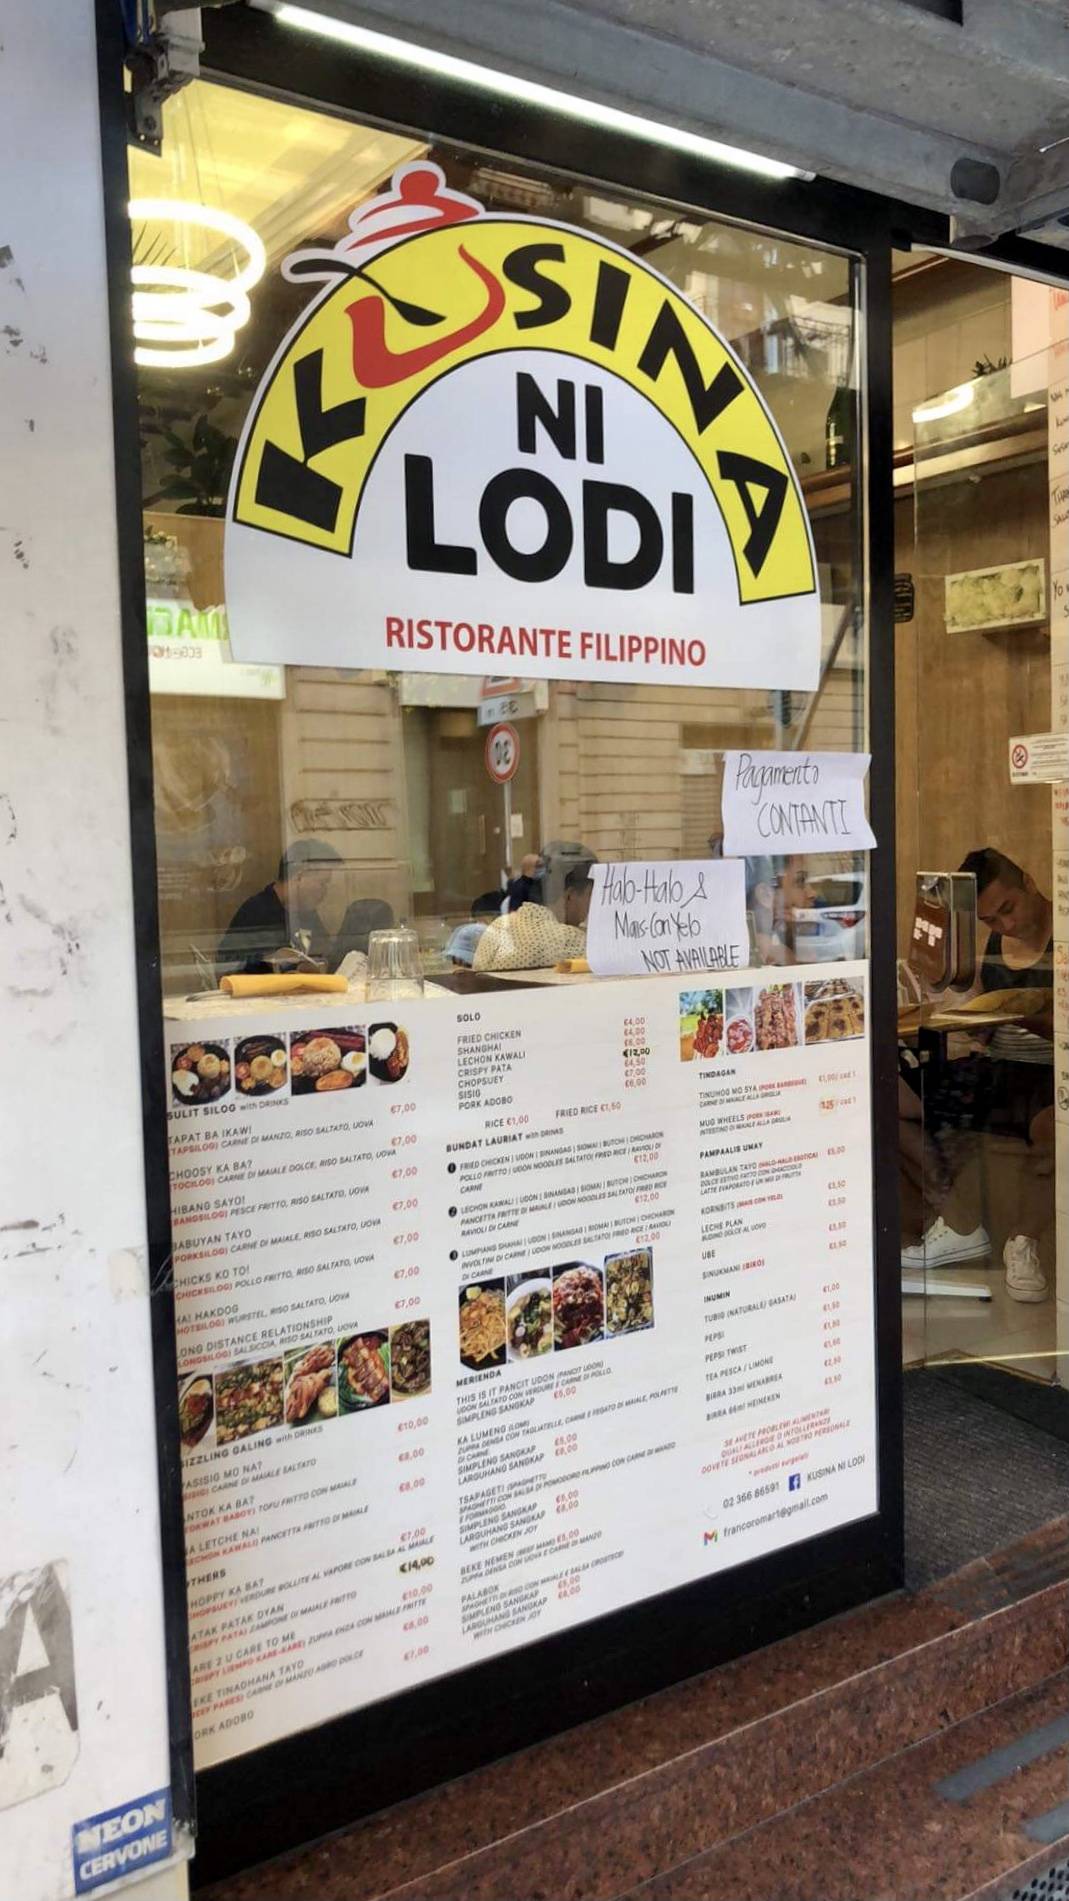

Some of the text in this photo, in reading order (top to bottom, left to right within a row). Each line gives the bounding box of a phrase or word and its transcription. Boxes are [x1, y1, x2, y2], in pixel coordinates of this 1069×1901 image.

[254, 243, 789, 578] KUSINA
[517, 372, 605, 464] NI
[404, 454, 695, 595] LODI
[385, 616, 707, 667] RISTORANTE FILIPPINO
[736, 753, 818, 805] Pagamento
[758, 800, 850, 838] CONTANTI
[601, 864, 683, 906] Halo-Halo
[641, 945, 740, 971] NOT AVAILABLE
[457, 1013, 481, 1023] SOLO
[457, 1030, 521, 1045] FRIED CHICKEN
[457, 1044, 502, 1055] SHANGHAI
[458, 1052, 526, 1066] LECHON KAWALI
[458, 1064, 512, 1078] CRISPY PATA
[699, 1068, 736, 1079] TINDAGAN
[458, 1076, 504, 1089] CHOPSUEY
[458, 1090, 481, 1099] SISIG
[203, 1104, 236, 1116] SILOG
[458, 1096, 513, 1110] PORK ADOBO
[555, 1105, 598, 1118] FRIED RICE
[718, 1114, 745, 1124] WHEELS
[485, 1115, 529, 1129] RICE €1,00
[205, 1130, 219, 1141] BA
[446, 1139, 482, 1152] BUNDAT
[486, 1133, 523, 1146] LAURIAT
[216, 1162, 230, 1173] KA
[725, 1218, 743, 1228] PLAN
[702, 1250, 716, 1260] UBE
[215, 1269, 229, 1281] KO
[703, 1291, 730, 1302] INUMIN
[207, 1316, 333, 1350] DISTANCE RELATIONSHIP
[704, 1331, 725, 1342] PEPSI
[705, 1345, 748, 1362] PEPSI TWIST
[705, 1372, 718, 1382] TEA
[720, 1366, 742, 1378] PESCA
[749, 1356, 774, 1369] LIMONE
[456, 1370, 501, 1388] MERIENDA
[456, 1393, 476, 1405] THIS
[478, 1391, 486, 1399] IS
[499, 1380, 529, 1393] PANCIT
[531, 1373, 554, 1386] UDON
[706, 1391, 726, 1402] BIRRA
[456, 1398, 535, 1426] SIMPLENG SANGKAP
[706, 1410, 727, 1421] BIRRA
[233, 1438, 272, 1456] GALING
[458, 1445, 536, 1475] SIMPLENG SANGKAP
[807, 1454, 866, 1482] KUSINA NI LODI
[722, 1482, 780, 1509] 02 366 86591
[187, 1569, 226, 1587] THERS
[77, 1798, 167, 1852] NEON
[79, 1829, 168, 1881] CERVONE
